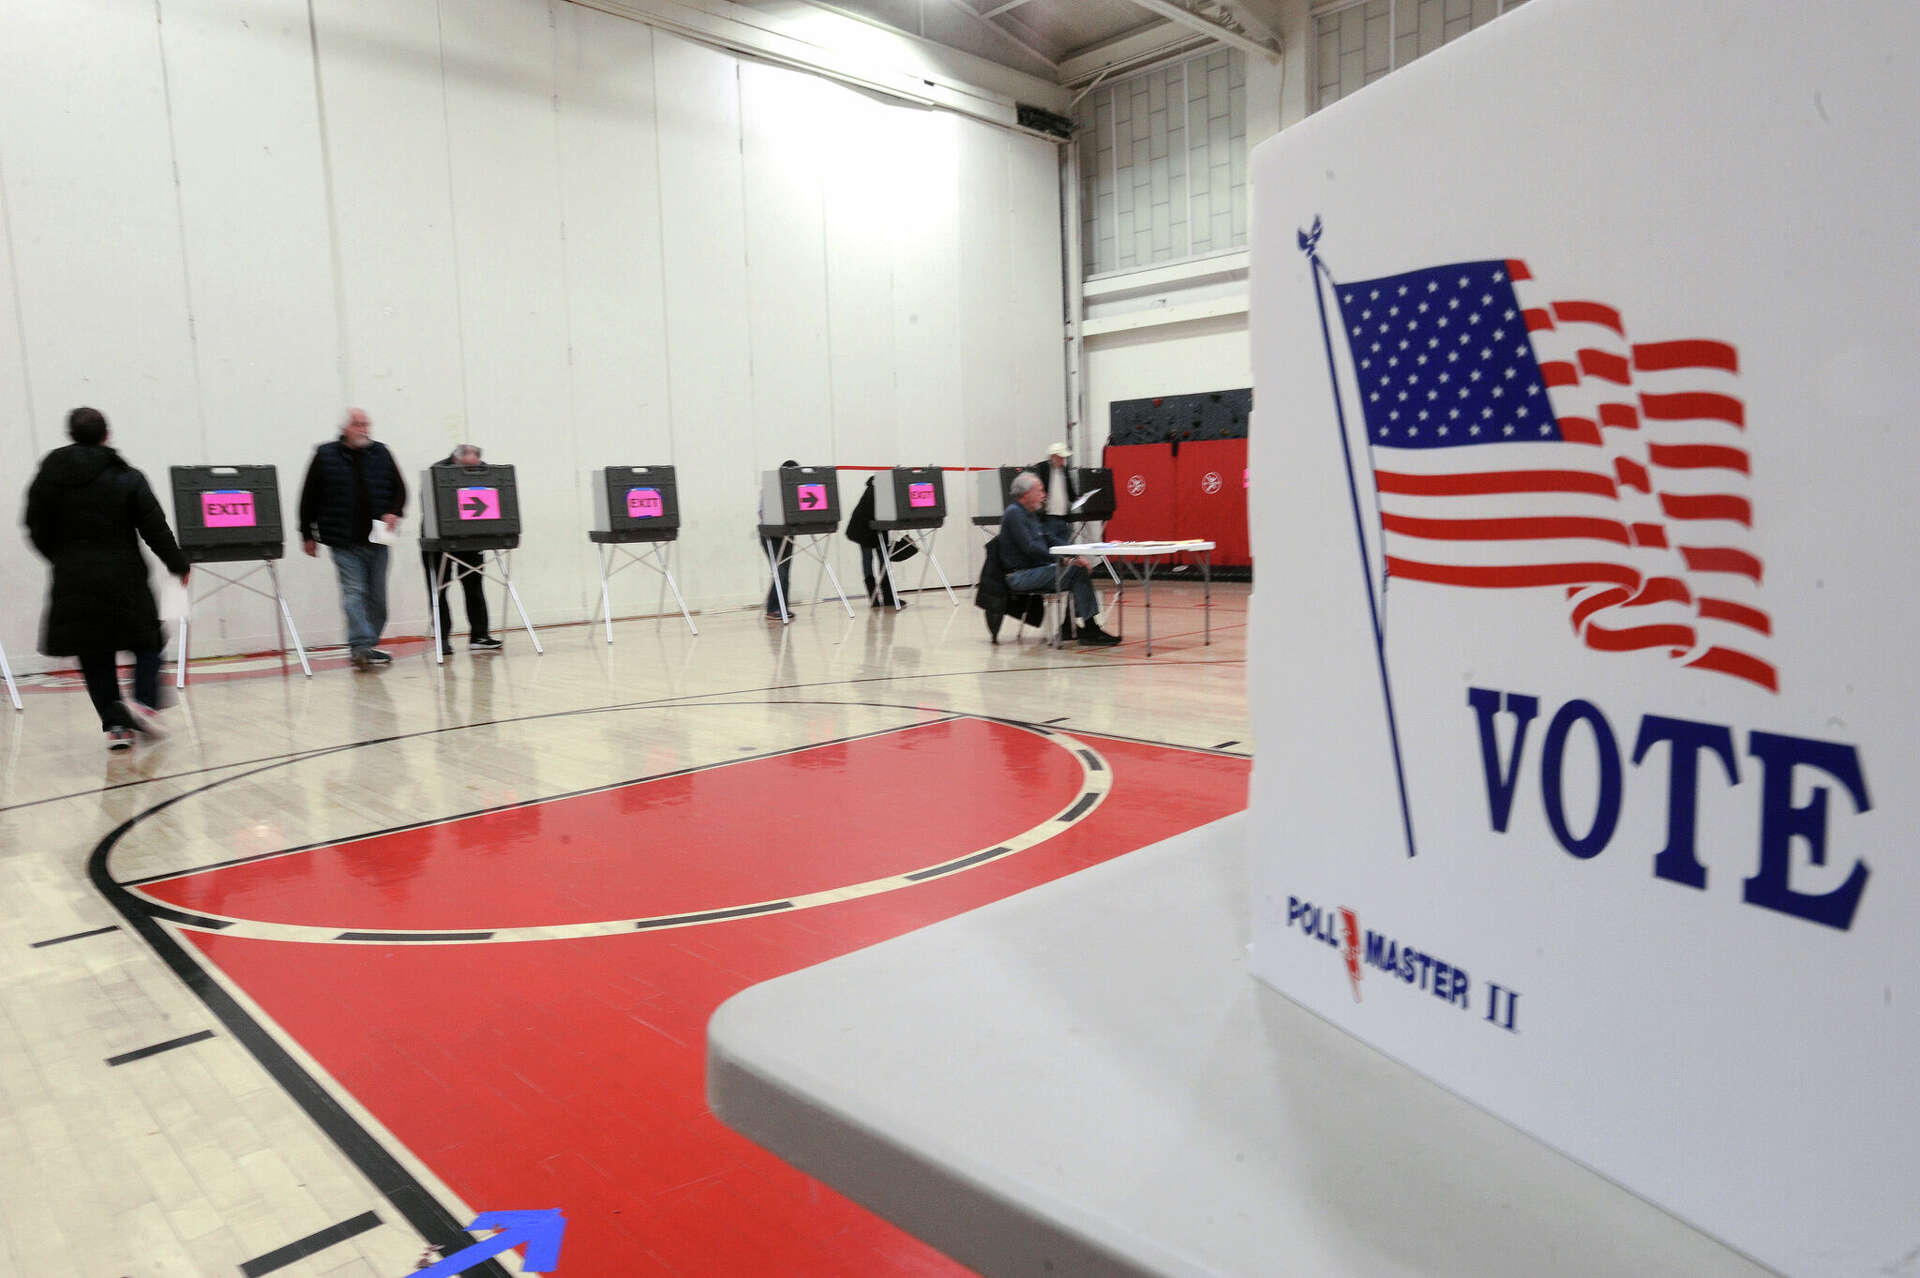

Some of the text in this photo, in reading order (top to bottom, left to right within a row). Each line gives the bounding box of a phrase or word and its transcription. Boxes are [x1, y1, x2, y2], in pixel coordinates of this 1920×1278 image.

[911, 490, 934, 500] EXIT
[207, 502, 250, 516] EXIT
[631, 497, 659, 508] EXIT
[1467, 686, 1873, 932] VOTE
[1287, 895, 1521, 1034] POLL MASTER II
